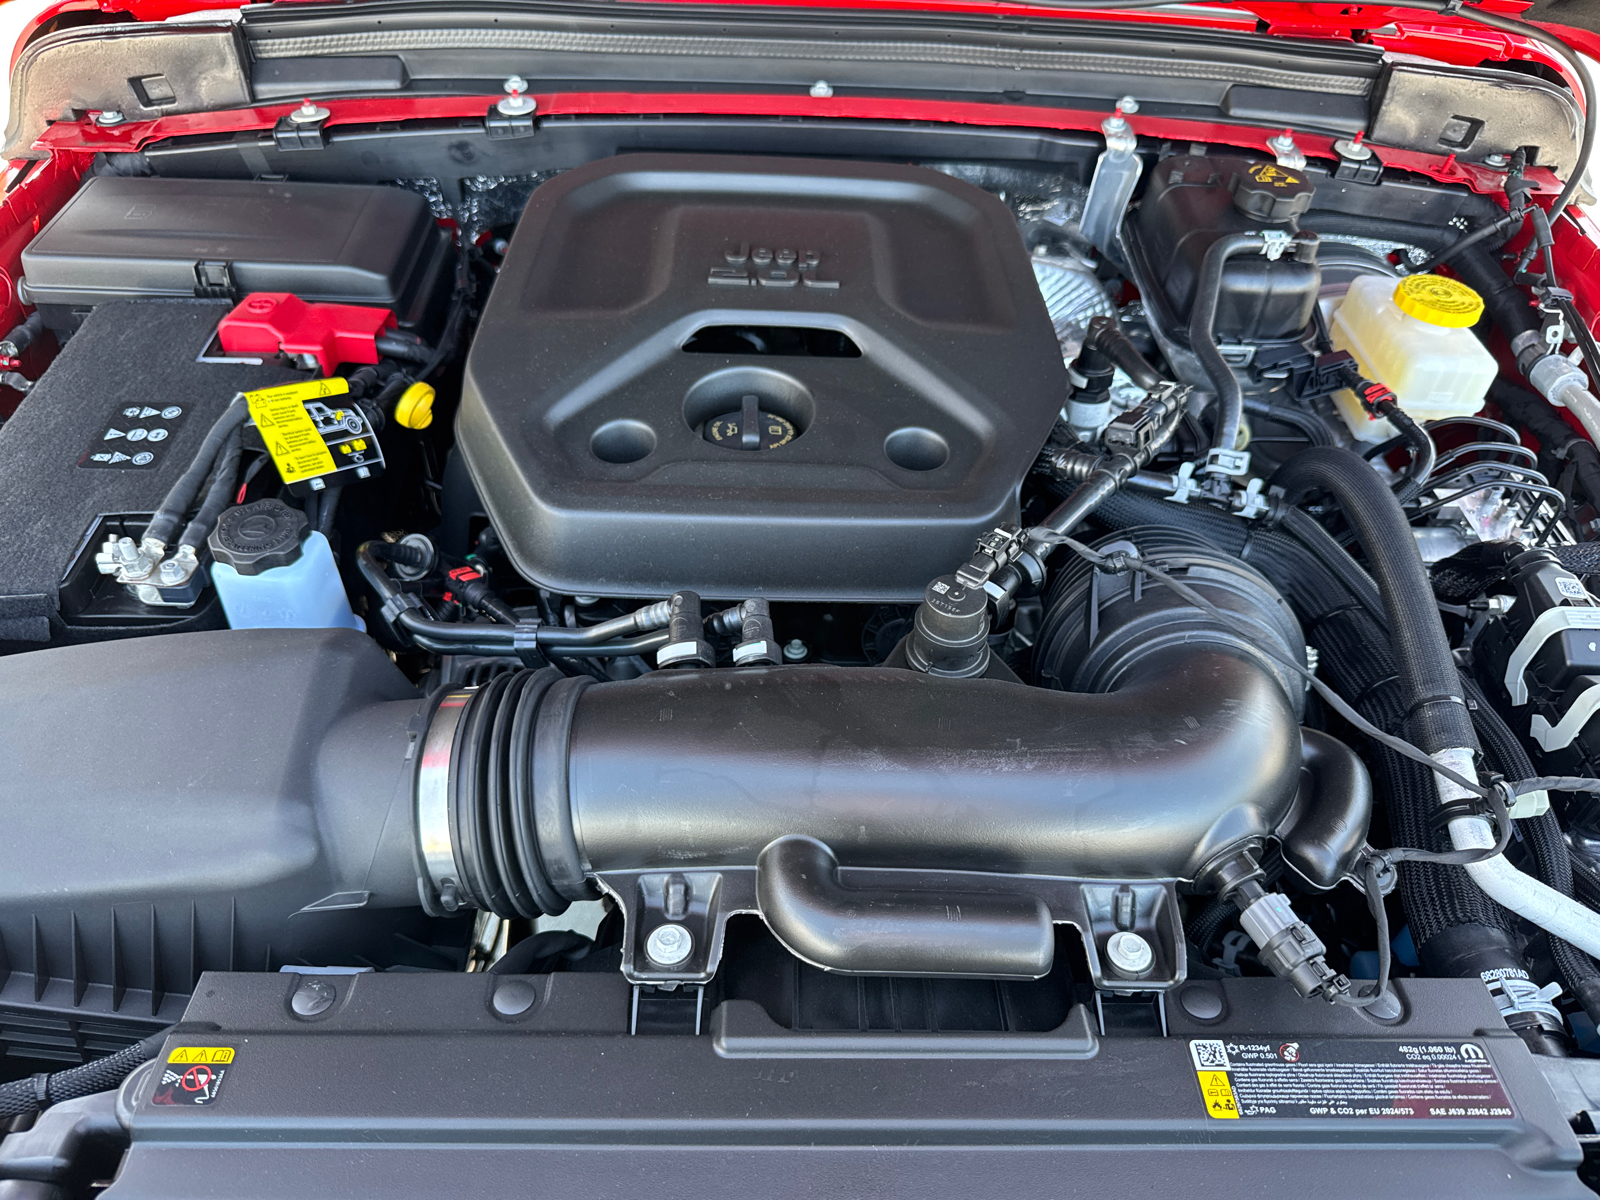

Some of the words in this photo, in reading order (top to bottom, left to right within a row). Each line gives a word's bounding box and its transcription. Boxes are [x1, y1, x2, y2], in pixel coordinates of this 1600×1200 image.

[724, 242, 821, 270] Jeep
[1260, 1052, 1278, 1060] 0.501
[1259, 1106, 1276, 1114] PAG
[1309, 1107, 1328, 1115] GWP
[1330, 1107, 1336, 1115] &
[1337, 1107, 1354, 1115] CO2
[1355, 1108, 1367, 1116] per
[1368, 1107, 1380, 1115] EU
[1429, 1107, 1446, 1116] SAE
